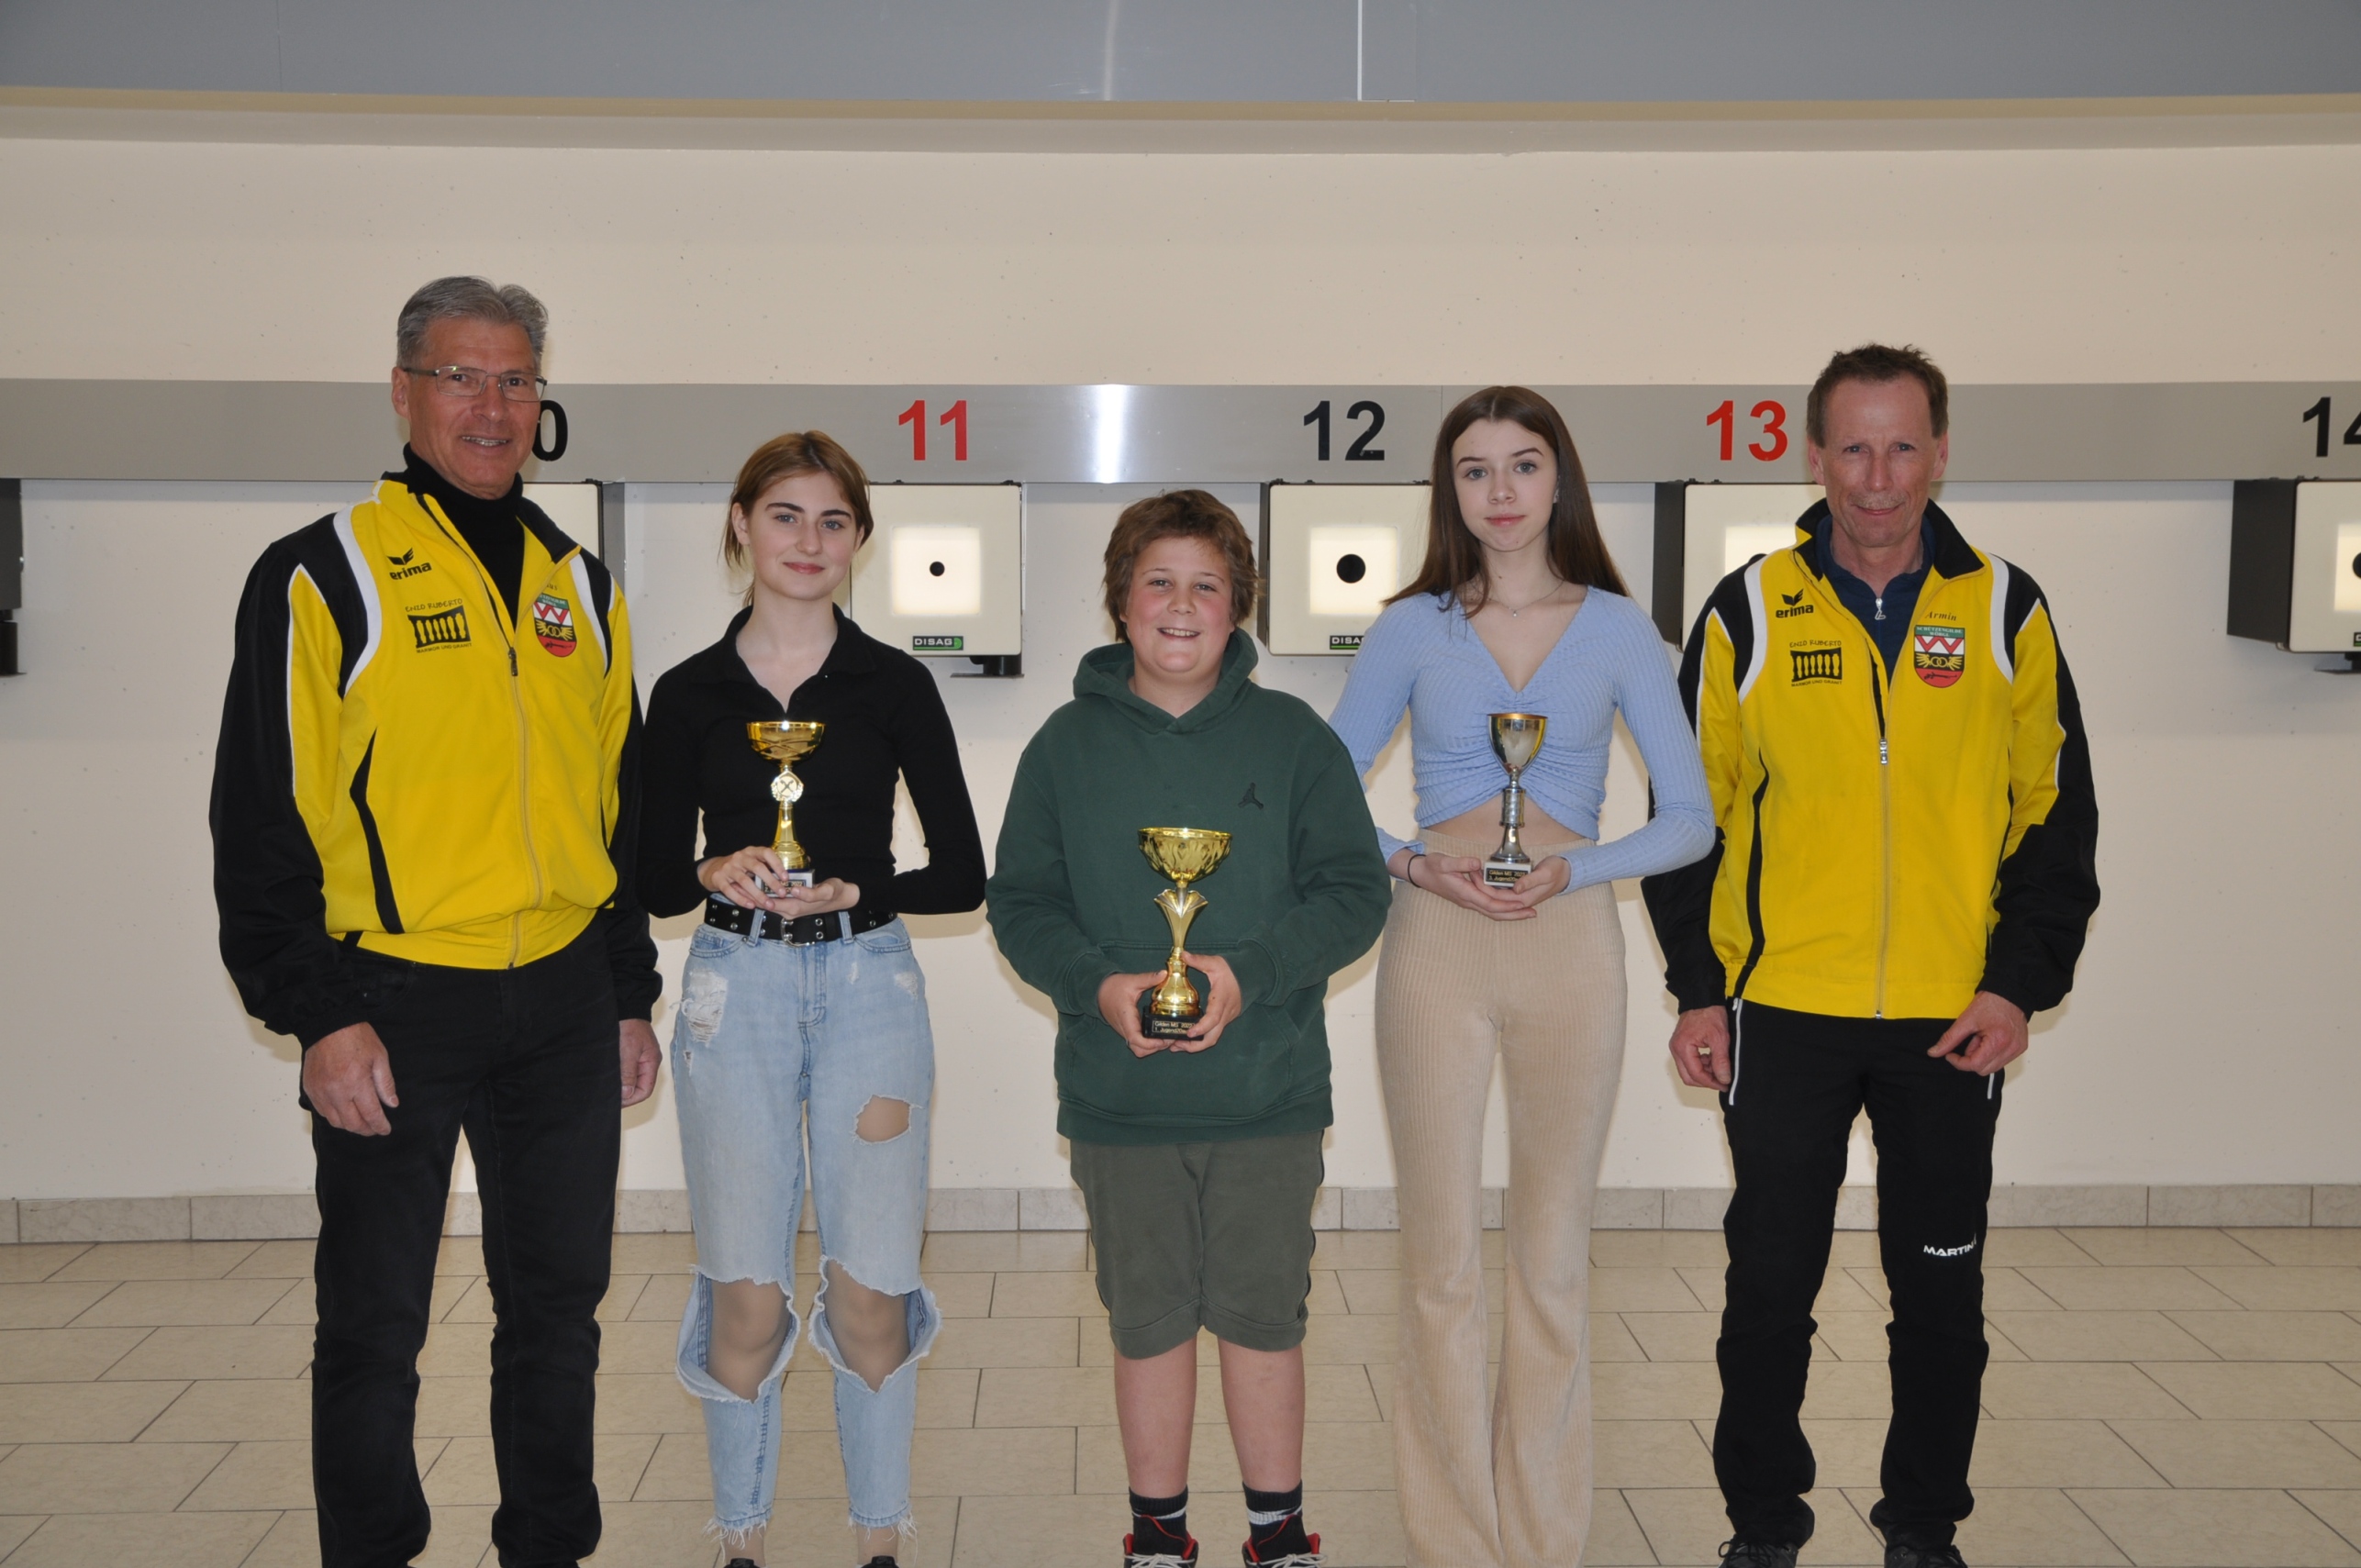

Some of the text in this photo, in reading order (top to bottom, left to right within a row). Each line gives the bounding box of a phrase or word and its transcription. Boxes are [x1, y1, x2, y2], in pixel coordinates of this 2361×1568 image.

[530, 399, 569, 462] 0
[897, 399, 968, 462] 11
[1302, 399, 1386, 462] 12
[1706, 399, 1788, 462] 13
[389, 562, 432, 580] erima
[405, 598, 463, 613] ENZO RUBERTO
[1776, 605, 1814, 618] erima
[1925, 611, 1957, 621] Armin
